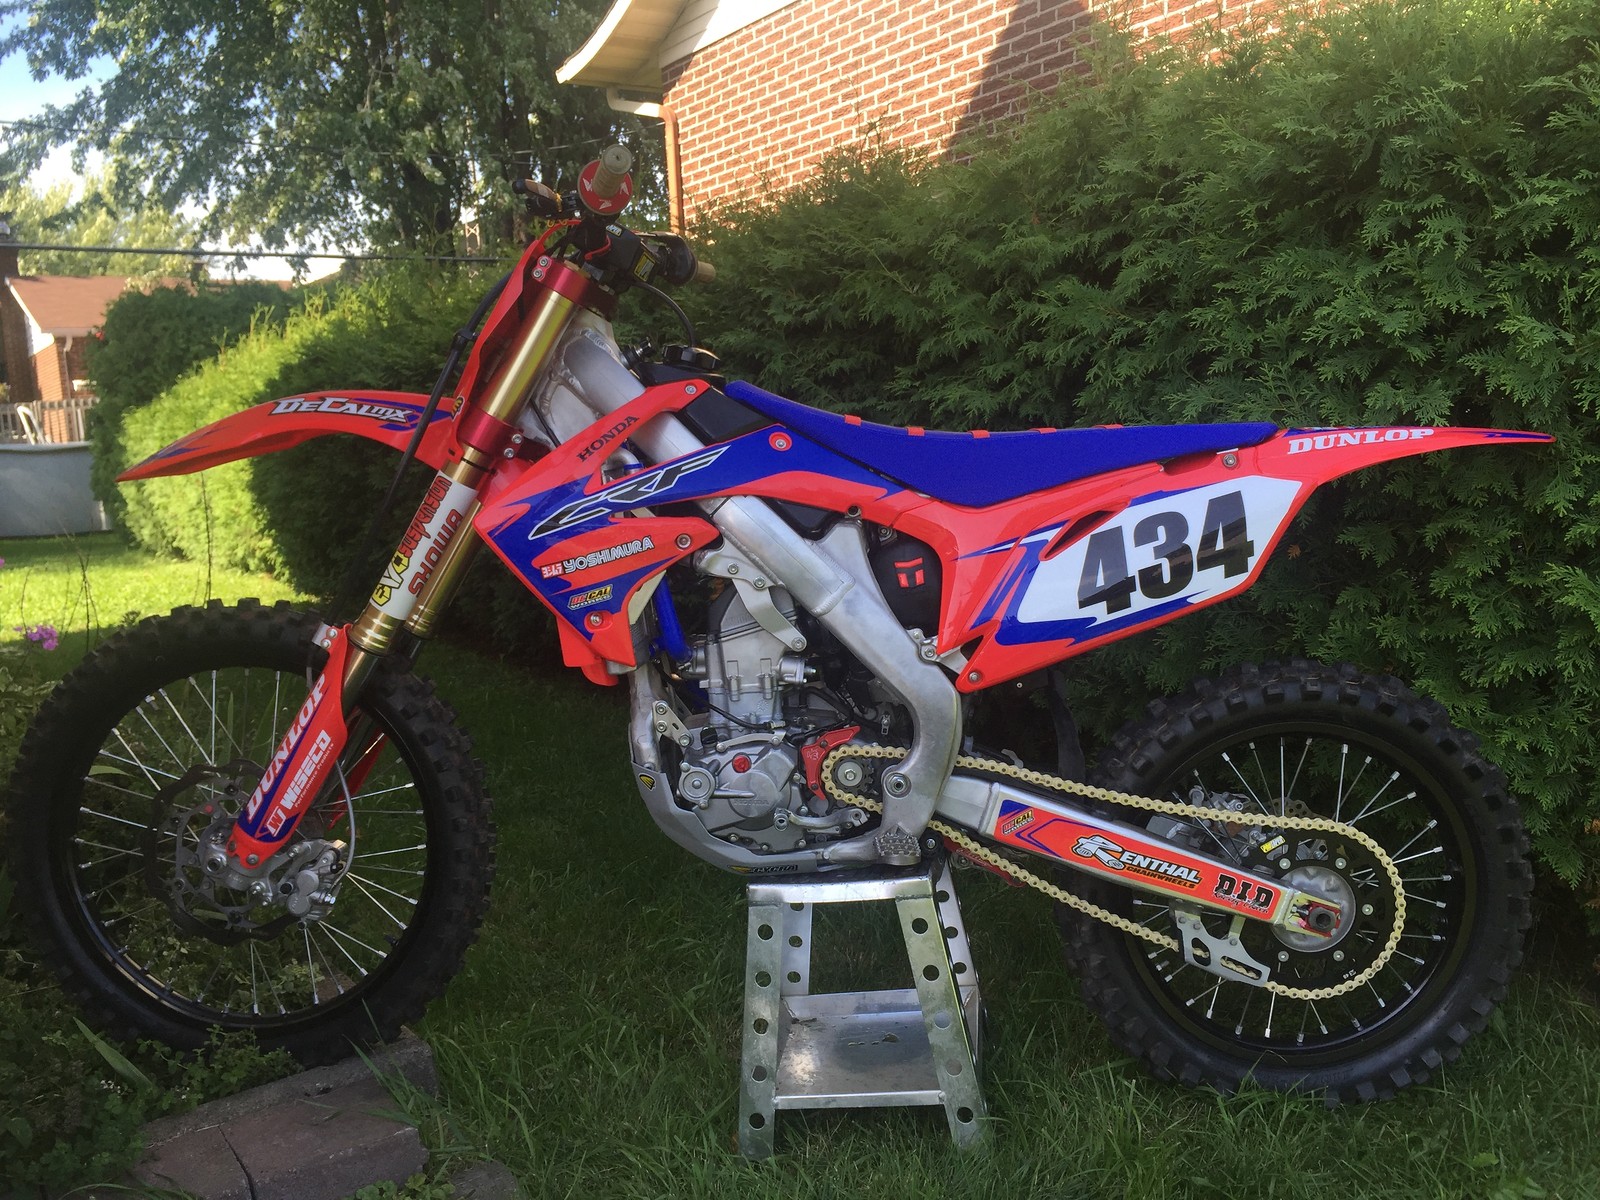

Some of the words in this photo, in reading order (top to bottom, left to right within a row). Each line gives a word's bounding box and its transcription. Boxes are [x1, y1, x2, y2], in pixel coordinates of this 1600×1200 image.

[576, 415, 640, 462] HONDA
[1287, 428, 1435, 455] DUNLOP
[528, 445, 731, 540] CRF
[408, 508, 464, 598] SHOWA
[563, 536, 655, 574] YOSHIMURA
[1077, 490, 1255, 615] 434
[246, 673, 325, 821] DUNLOP
[294, 771, 319, 808] Performance
[1071, 835, 1201, 884] RENTHAL
[1126, 865, 1197, 890] CHAINWHEELS
